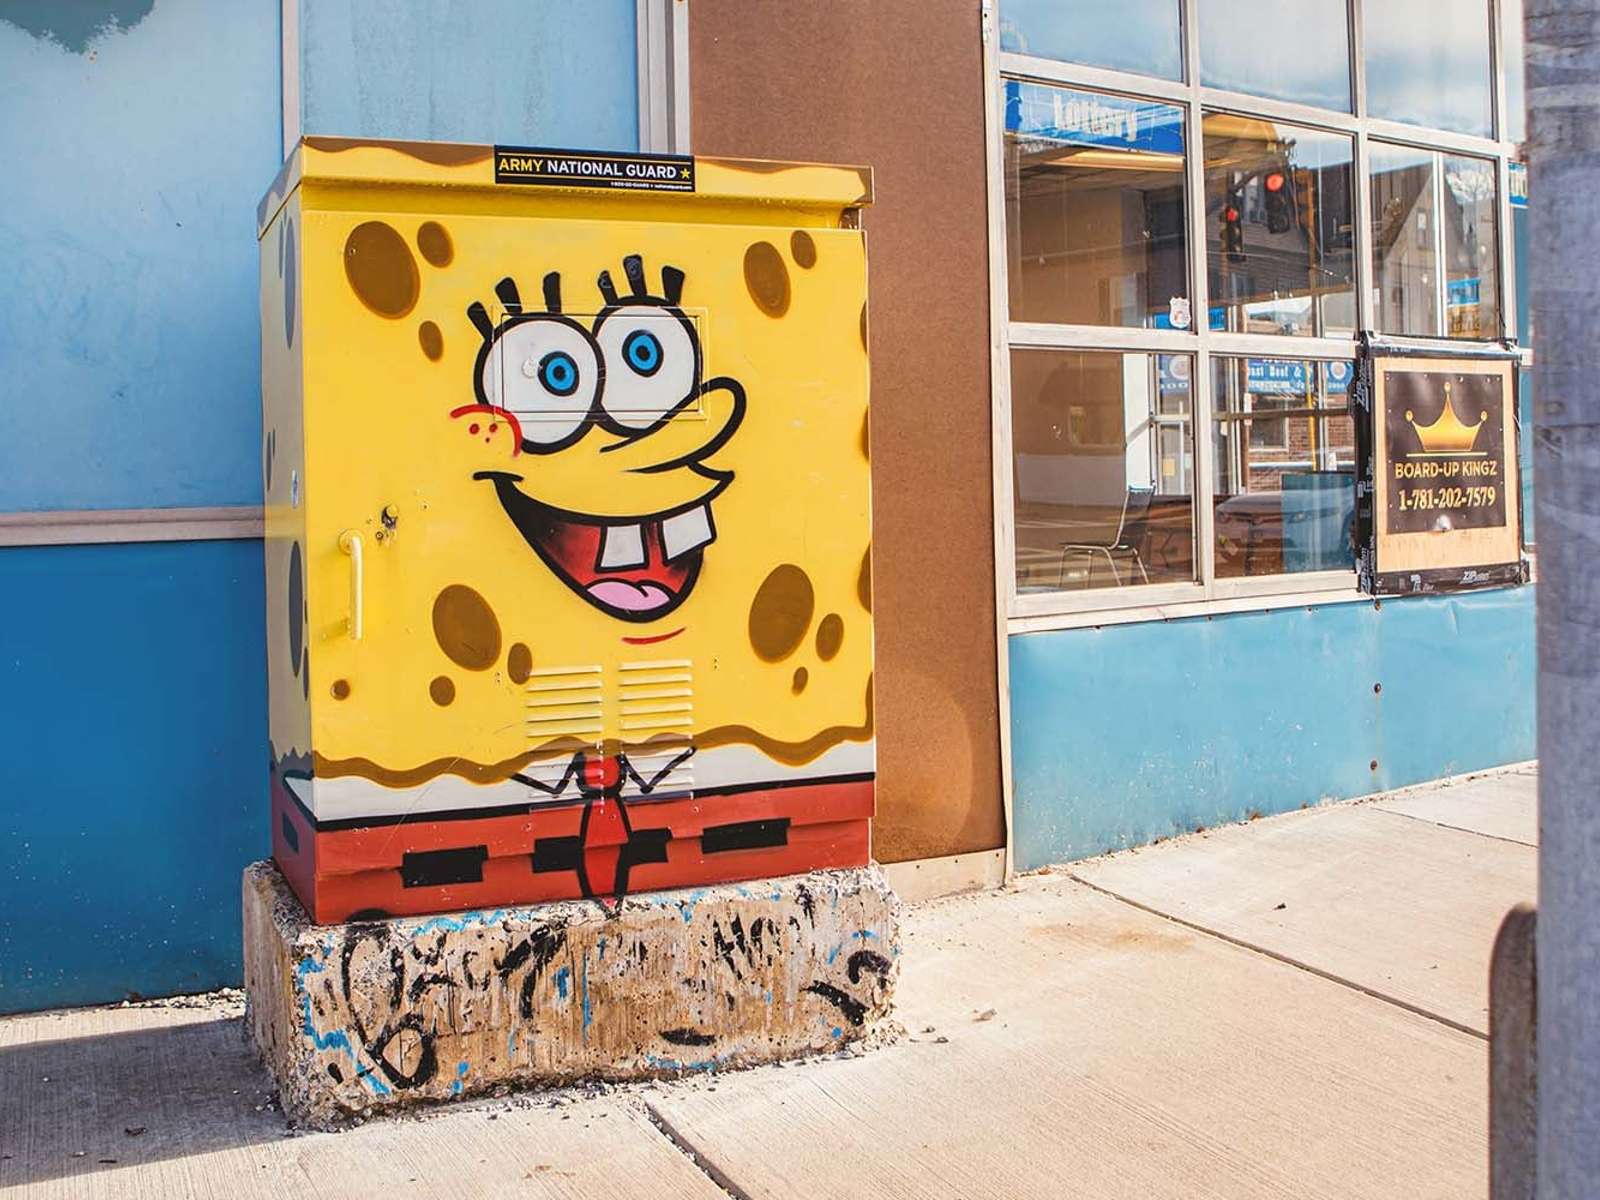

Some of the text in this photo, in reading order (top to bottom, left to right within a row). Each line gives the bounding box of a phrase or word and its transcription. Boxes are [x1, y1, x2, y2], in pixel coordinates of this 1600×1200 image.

[498, 158, 677, 179] ARMY NATIONAL GUARD
[1395, 460, 1498, 479] BOARD-UP KINGZ
[1399, 486, 1496, 511] 1-781-202-7579
